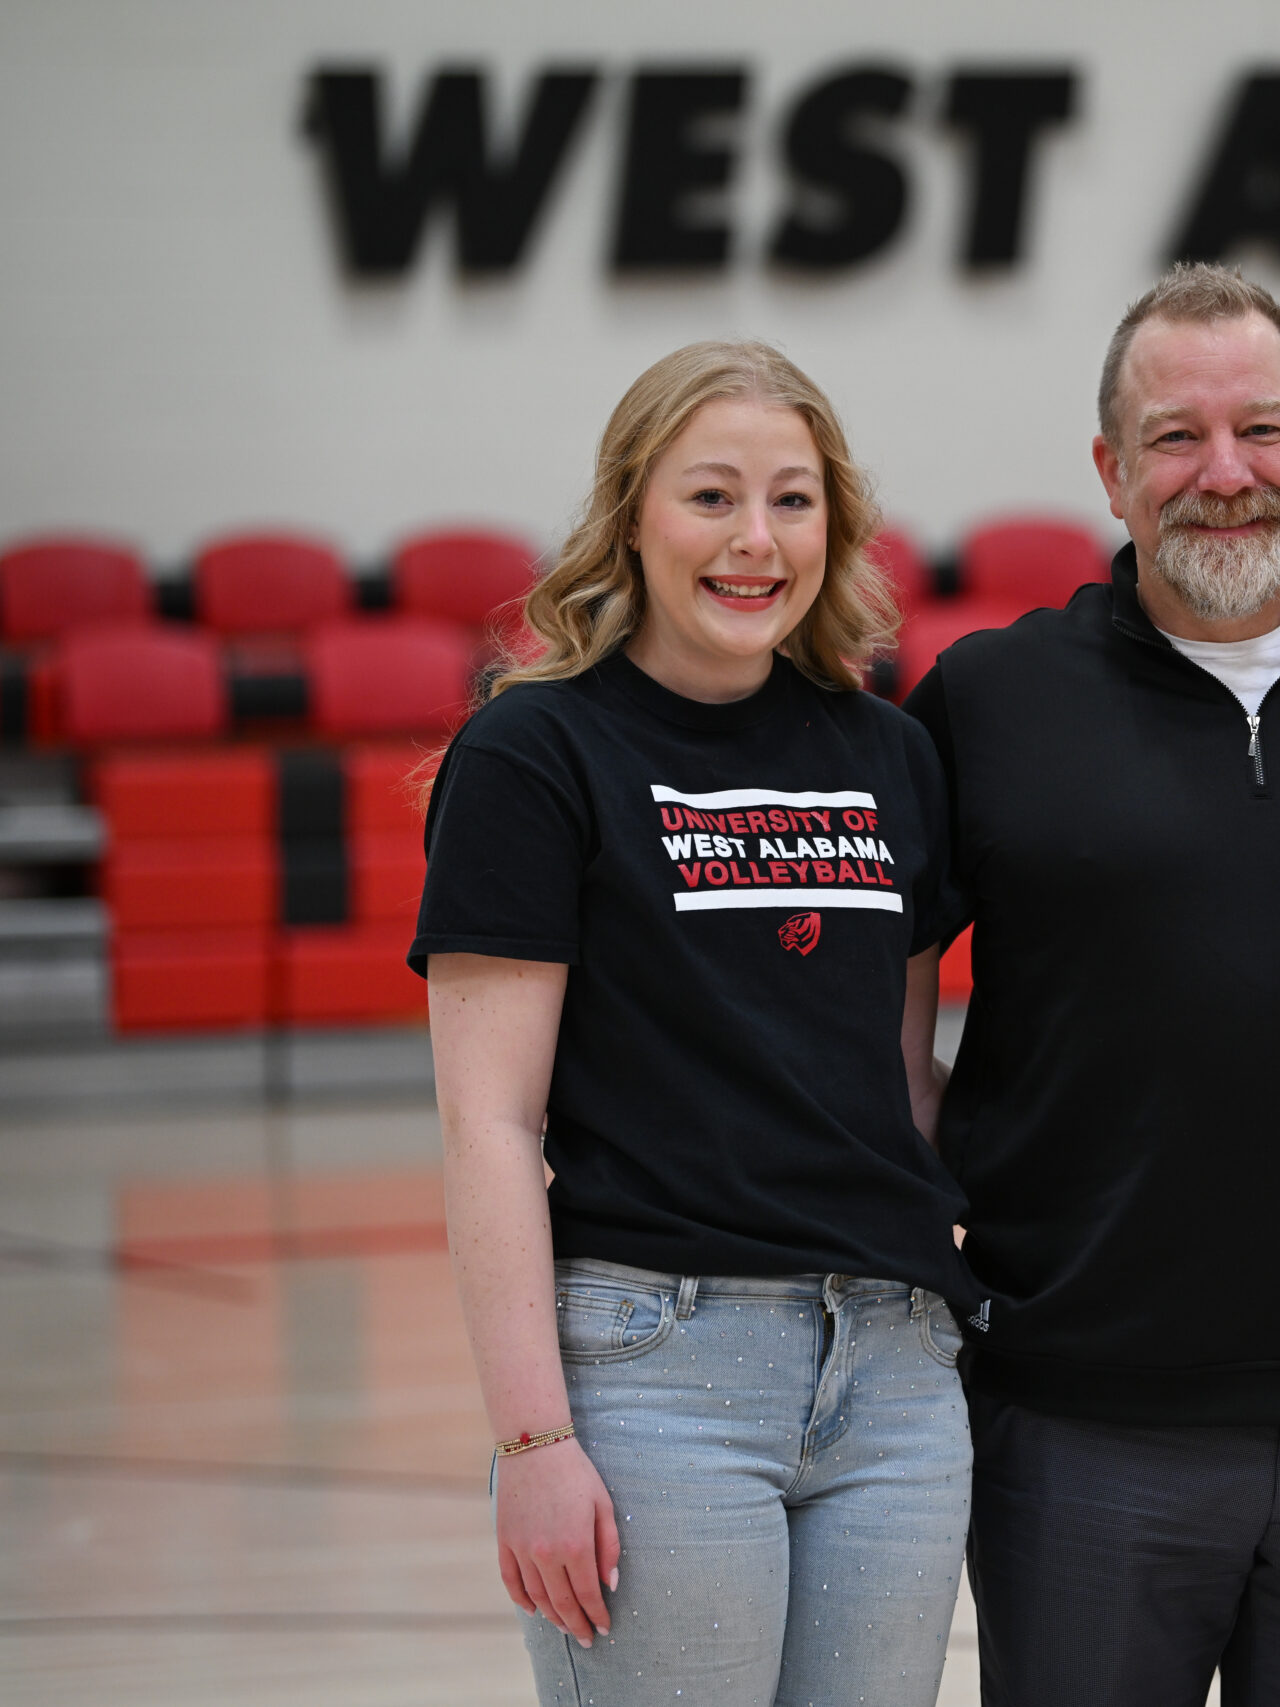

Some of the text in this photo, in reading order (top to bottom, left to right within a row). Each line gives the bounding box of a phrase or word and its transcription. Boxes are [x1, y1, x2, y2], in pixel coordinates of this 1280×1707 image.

[304, 64, 1079, 272] WEST
[660, 807, 879, 834] UNIVERSITY OF
[661, 833, 895, 864] WEST ALABAMA
[677, 860, 893, 888] VOLLEYBALL
